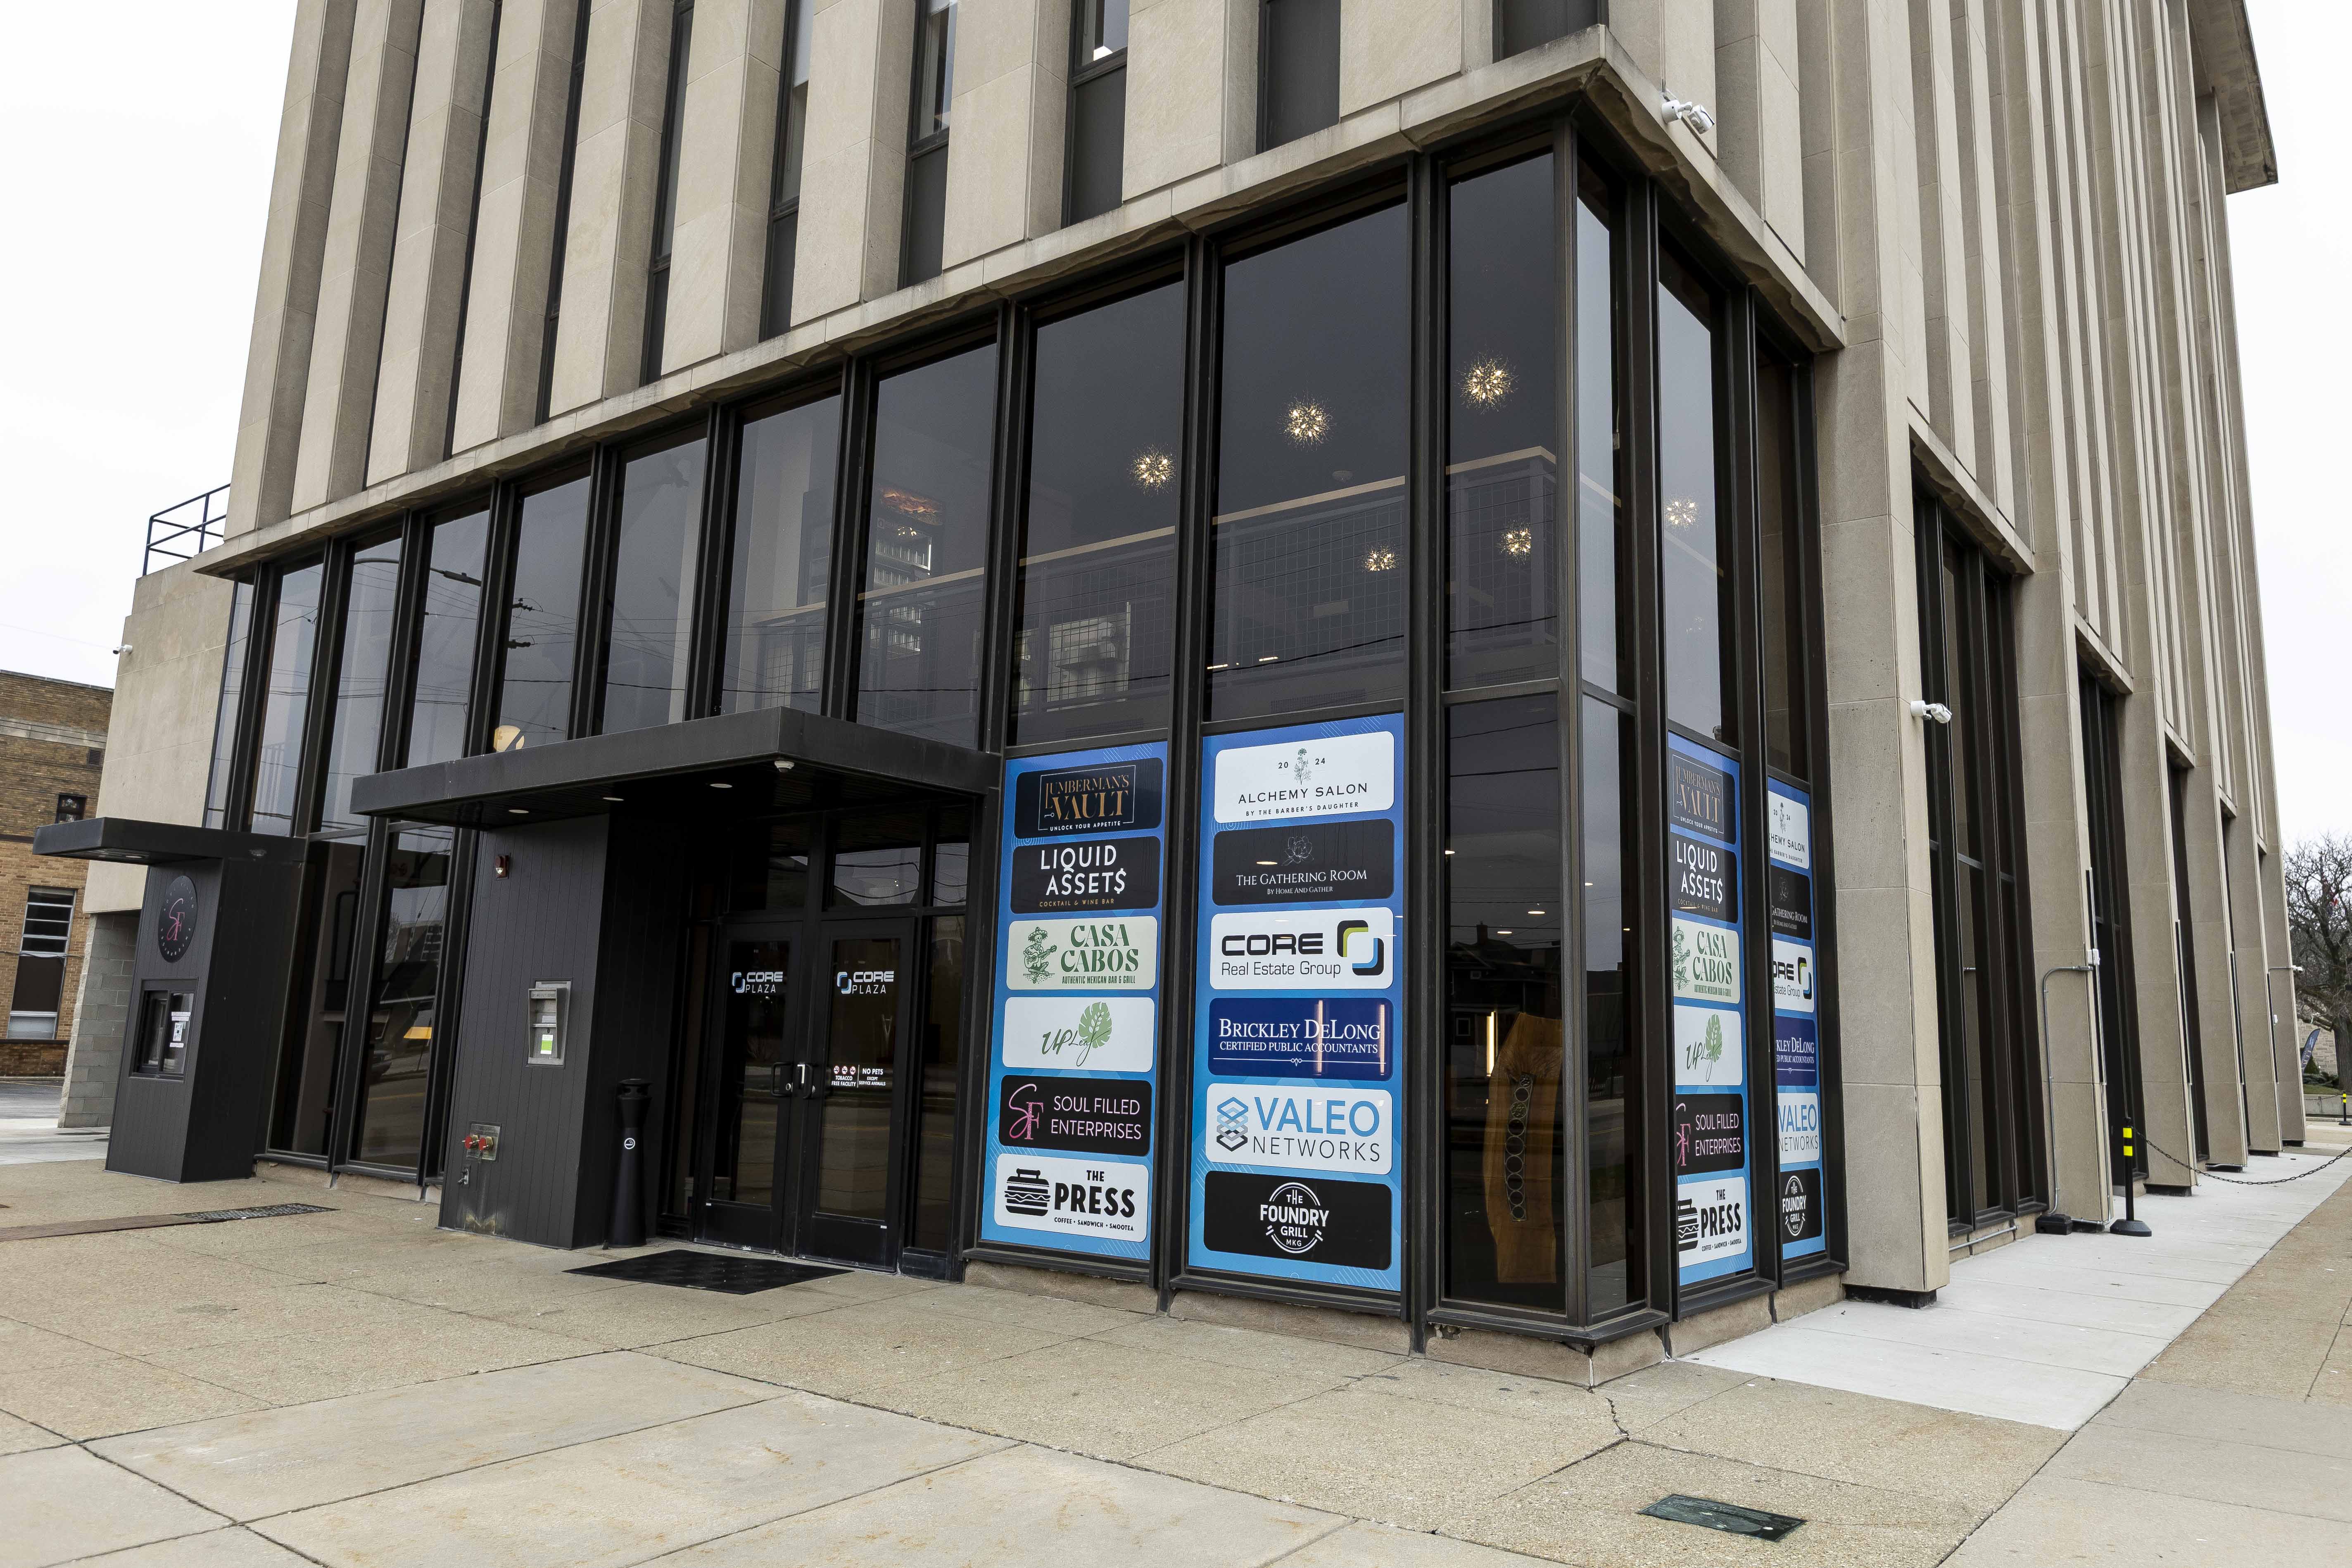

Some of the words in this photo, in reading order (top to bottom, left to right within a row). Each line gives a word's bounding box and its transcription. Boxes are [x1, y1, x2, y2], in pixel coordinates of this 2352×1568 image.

[1045, 774, 1130, 809] LUMBERMAN'S
[1238, 788, 1309, 804] ALCHEMY
[1315, 783, 1368, 797] SALON
[1052, 790, 1129, 820] VAULT
[1276, 806, 1313, 814] BARBER'S
[1317, 802, 1359, 811] DAUGHTER
[1680, 784, 1720, 823] VAULT
[1680, 816, 1693, 825] UNLOCK
[1703, 824, 1718, 834] APPETITE
[1771, 833, 1785, 846] HEMY
[1787, 839, 1805, 853] SALON
[1041, 845, 1117, 873] LIQUID
[1677, 840, 1717, 873] LIQUID
[1071, 924, 1130, 948] CASA
[1221, 932, 1323, 956] CORE
[1697, 931, 1727, 958] CASA
[1060, 949, 1139, 972] CABOS
[1221, 962, 1248, 976] Real
[1254, 961, 1295, 975] Estate
[1300, 961, 1341, 979] Group
[746, 971, 783, 982] CORE
[853, 971, 894, 982] CORE
[1062, 975, 1086, 984] AUTHENTIC
[1087, 975, 1107, 984] MEXICAN
[1108, 975, 1117, 984] BAR
[1123, 975, 1136, 984] GRILL
[1693, 956, 1732, 985] CABOS
[1773, 961, 1794, 981] ORE
[745, 984, 776, 993] PLAZA
[852, 984, 886, 994] PLAZA
[1775, 985, 1786, 995] state
[1787, 984, 1800, 1000] Group
[1220, 1041, 1266, 1051] CERTIFIED
[1269, 1042, 1303, 1052] PUBLIC
[1304, 1043, 1378, 1054] ACCOUNTANTS
[1776, 1039, 1790, 1052] KLEY
[1053, 1096, 1090, 1113] SOUL
[1094, 1098, 1140, 1115] FILLED
[1254, 1097, 1380, 1137] VALEO
[1695, 1114, 1715, 1131] SOUL
[1717, 1113, 1739, 1129] FILLED
[1778, 1104, 1817, 1133] VALEO
[1051, 1119, 1142, 1140] ENTERPRISES
[1252, 1136, 1380, 1162] NETWORKS
[1695, 1137, 1741, 1156] ENTERPRISES
[1086, 1169, 1105, 1182] THE
[1054, 1182, 1136, 1218] PRESS
[1286, 1189, 1303, 1205] THE
[1716, 1189, 1725, 1201] THE
[1782, 1195, 1806, 1213] FOUNDRY
[1077, 1219, 1104, 1228] SANDWICH
[1109, 1223, 1134, 1231] SMOOTEA
[1260, 1204, 1329, 1227] FOUNDRY
[1701, 1202, 1741, 1238] PRESS
[1790, 1212, 1800, 1223] GRILL
[1280, 1226, 1308, 1238] GRILL
[1286, 1238, 1302, 1247] MKG
[1714, 1241, 1727, 1249] SANDWICH
